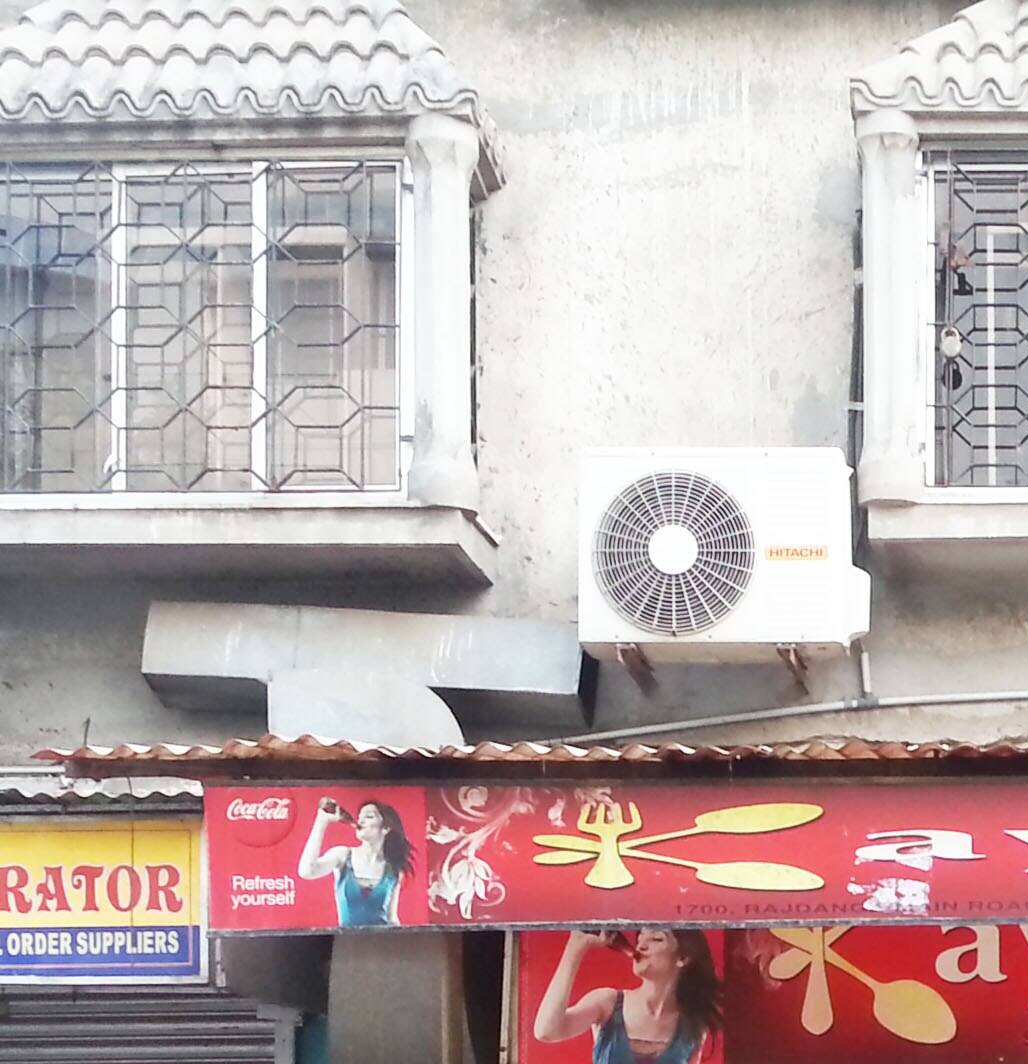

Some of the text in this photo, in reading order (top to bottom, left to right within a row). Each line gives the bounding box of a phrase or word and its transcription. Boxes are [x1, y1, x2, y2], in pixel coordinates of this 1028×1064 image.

[769, 547, 824, 558] HITACHI
[226, 797, 292, 821] Coca-Cola
[0, 864, 183, 914] RATOR
[231, 875, 295, 891] Refresh
[230, 891, 297, 911] yourself
[7, 931, 180, 956] ORDER SUPPLIERS
